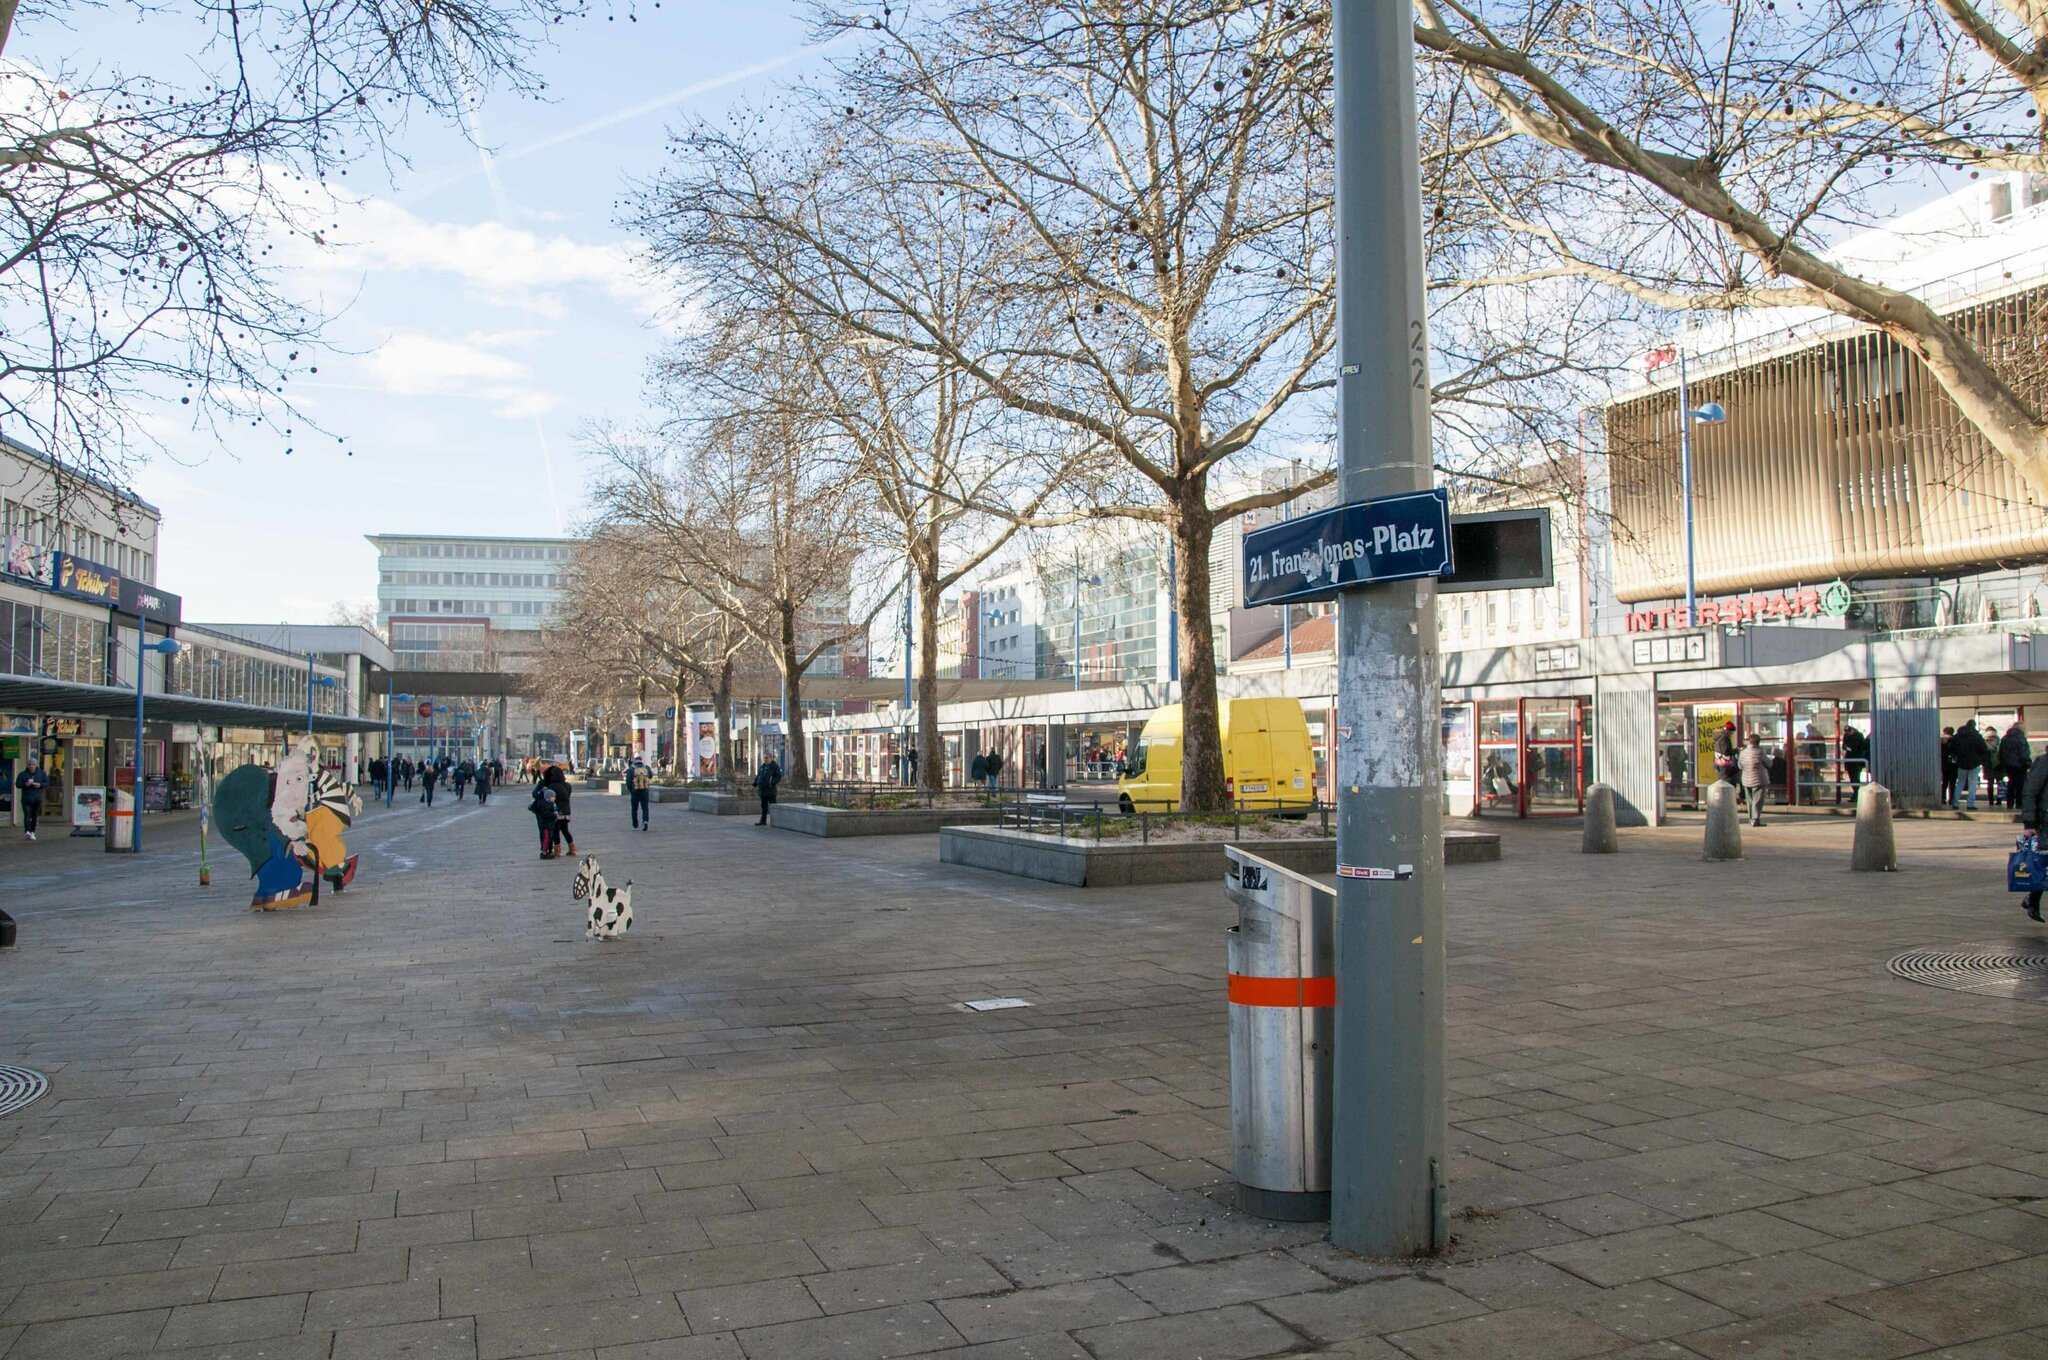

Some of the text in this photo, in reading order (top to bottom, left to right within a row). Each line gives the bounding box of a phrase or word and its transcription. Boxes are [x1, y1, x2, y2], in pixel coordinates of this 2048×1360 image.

[1250, 523, 1435, 583] 21., FranzJonas-Platz
[75, 568, 109, 597] Tchibo
[1625, 590, 1820, 632] INTERSPAR
[56, 718, 81, 735] Tchibo
[1699, 739, 1716, 753] tike
